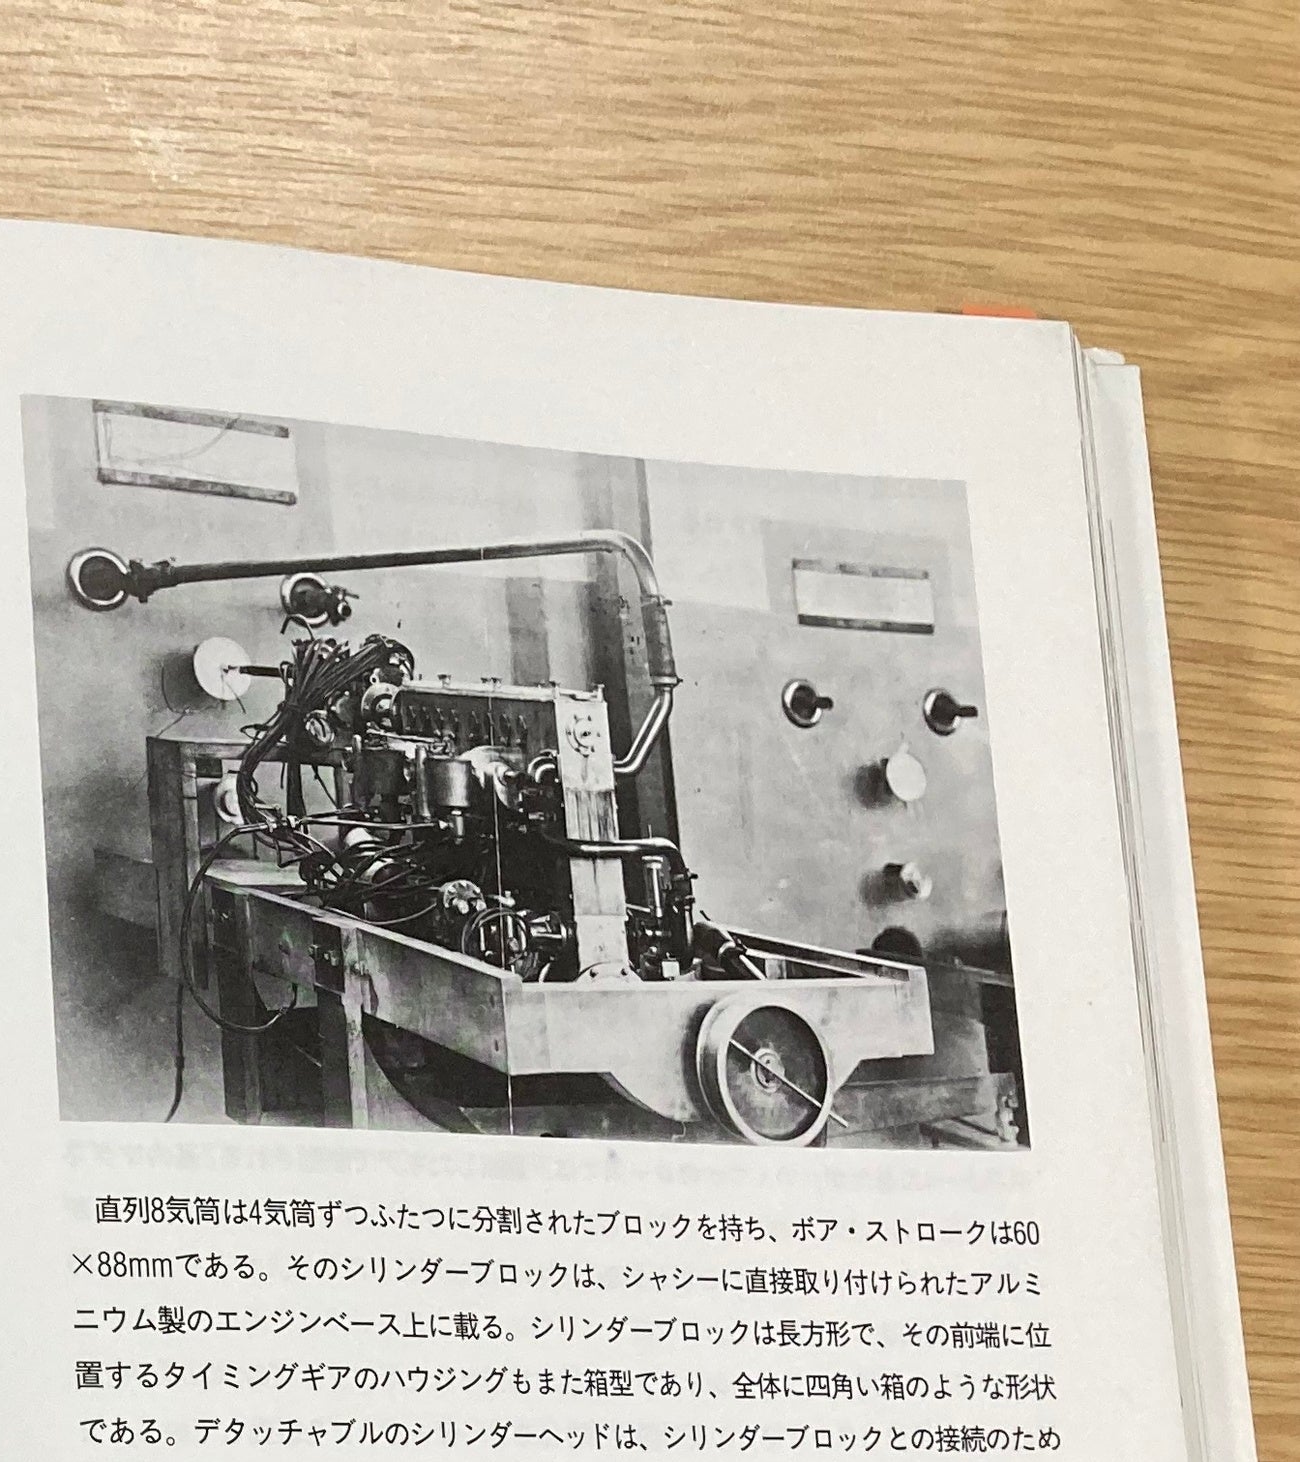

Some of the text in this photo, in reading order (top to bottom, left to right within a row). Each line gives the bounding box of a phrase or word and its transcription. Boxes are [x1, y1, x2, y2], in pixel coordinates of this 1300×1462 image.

[95, 1194, 1039, 1245] 直列8気筒は4気筒ずつふたつに分割されたブロックを持ち、ボア・ストロークは60
[72, 1251, 1040, 1296] ×88mmである。そのシリンダーブロックは、シャシーに直接取り付けられたアルミ
[74, 1305, 1052, 1349] ニウム製のエンジンベース上に載る。シリンダーブロックは長方形で、その前端に位
[75, 1361, 1057, 1401] 置するタイミングギアのハウジングもまた箱型であり、全体に四角い箱のような形状
[80, 1417, 1061, 1453] である。デタッチャブルのシリンダーヘッドは、シリンダーブロックとの接続のため
